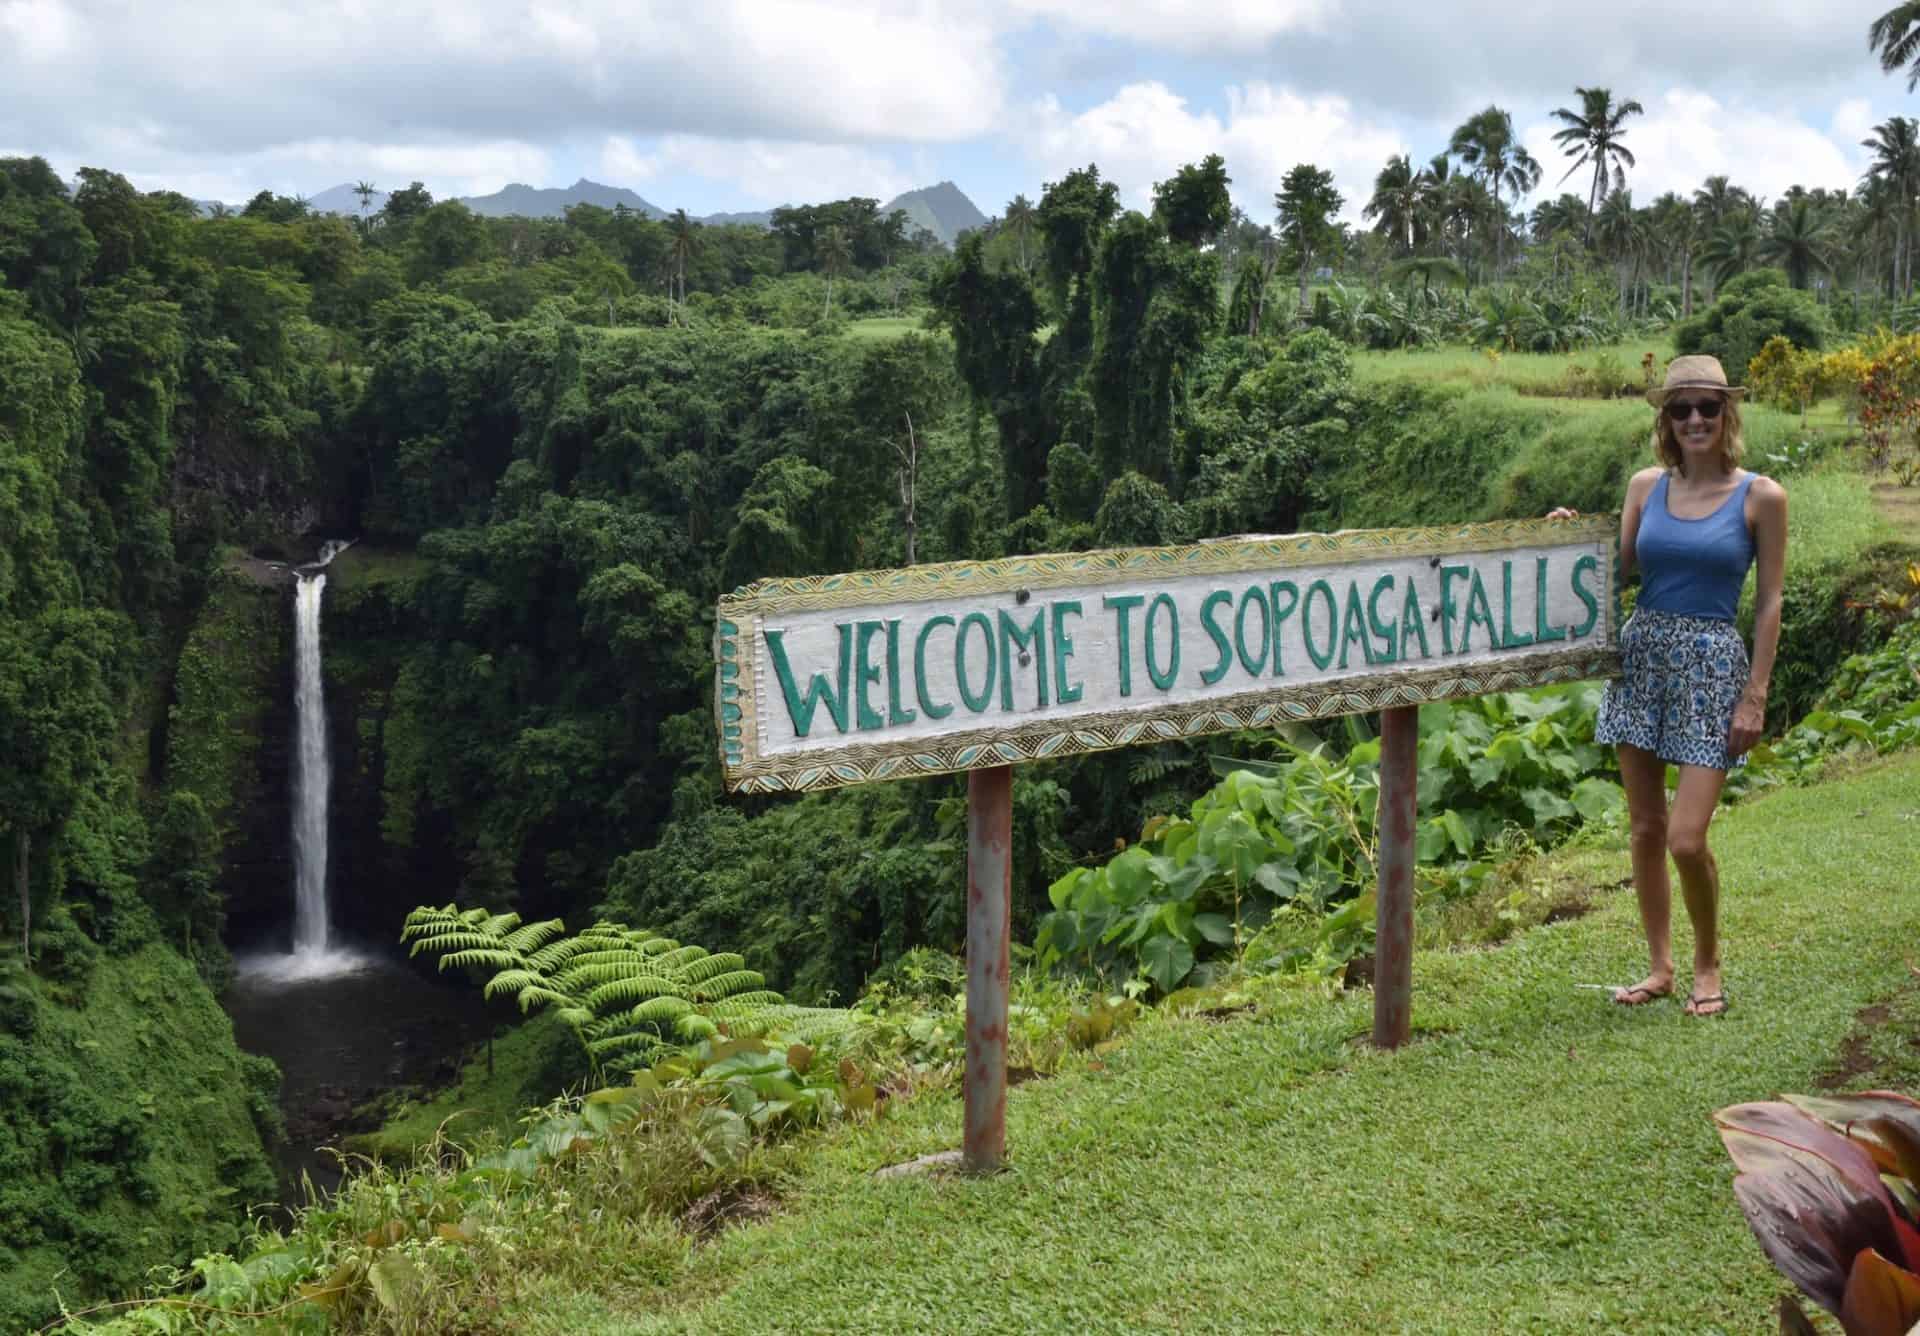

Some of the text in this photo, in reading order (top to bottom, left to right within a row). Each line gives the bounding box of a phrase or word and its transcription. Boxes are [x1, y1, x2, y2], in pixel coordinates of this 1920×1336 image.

[763, 553, 1600, 737] WELCOME TO SOPOAGA FALLS
